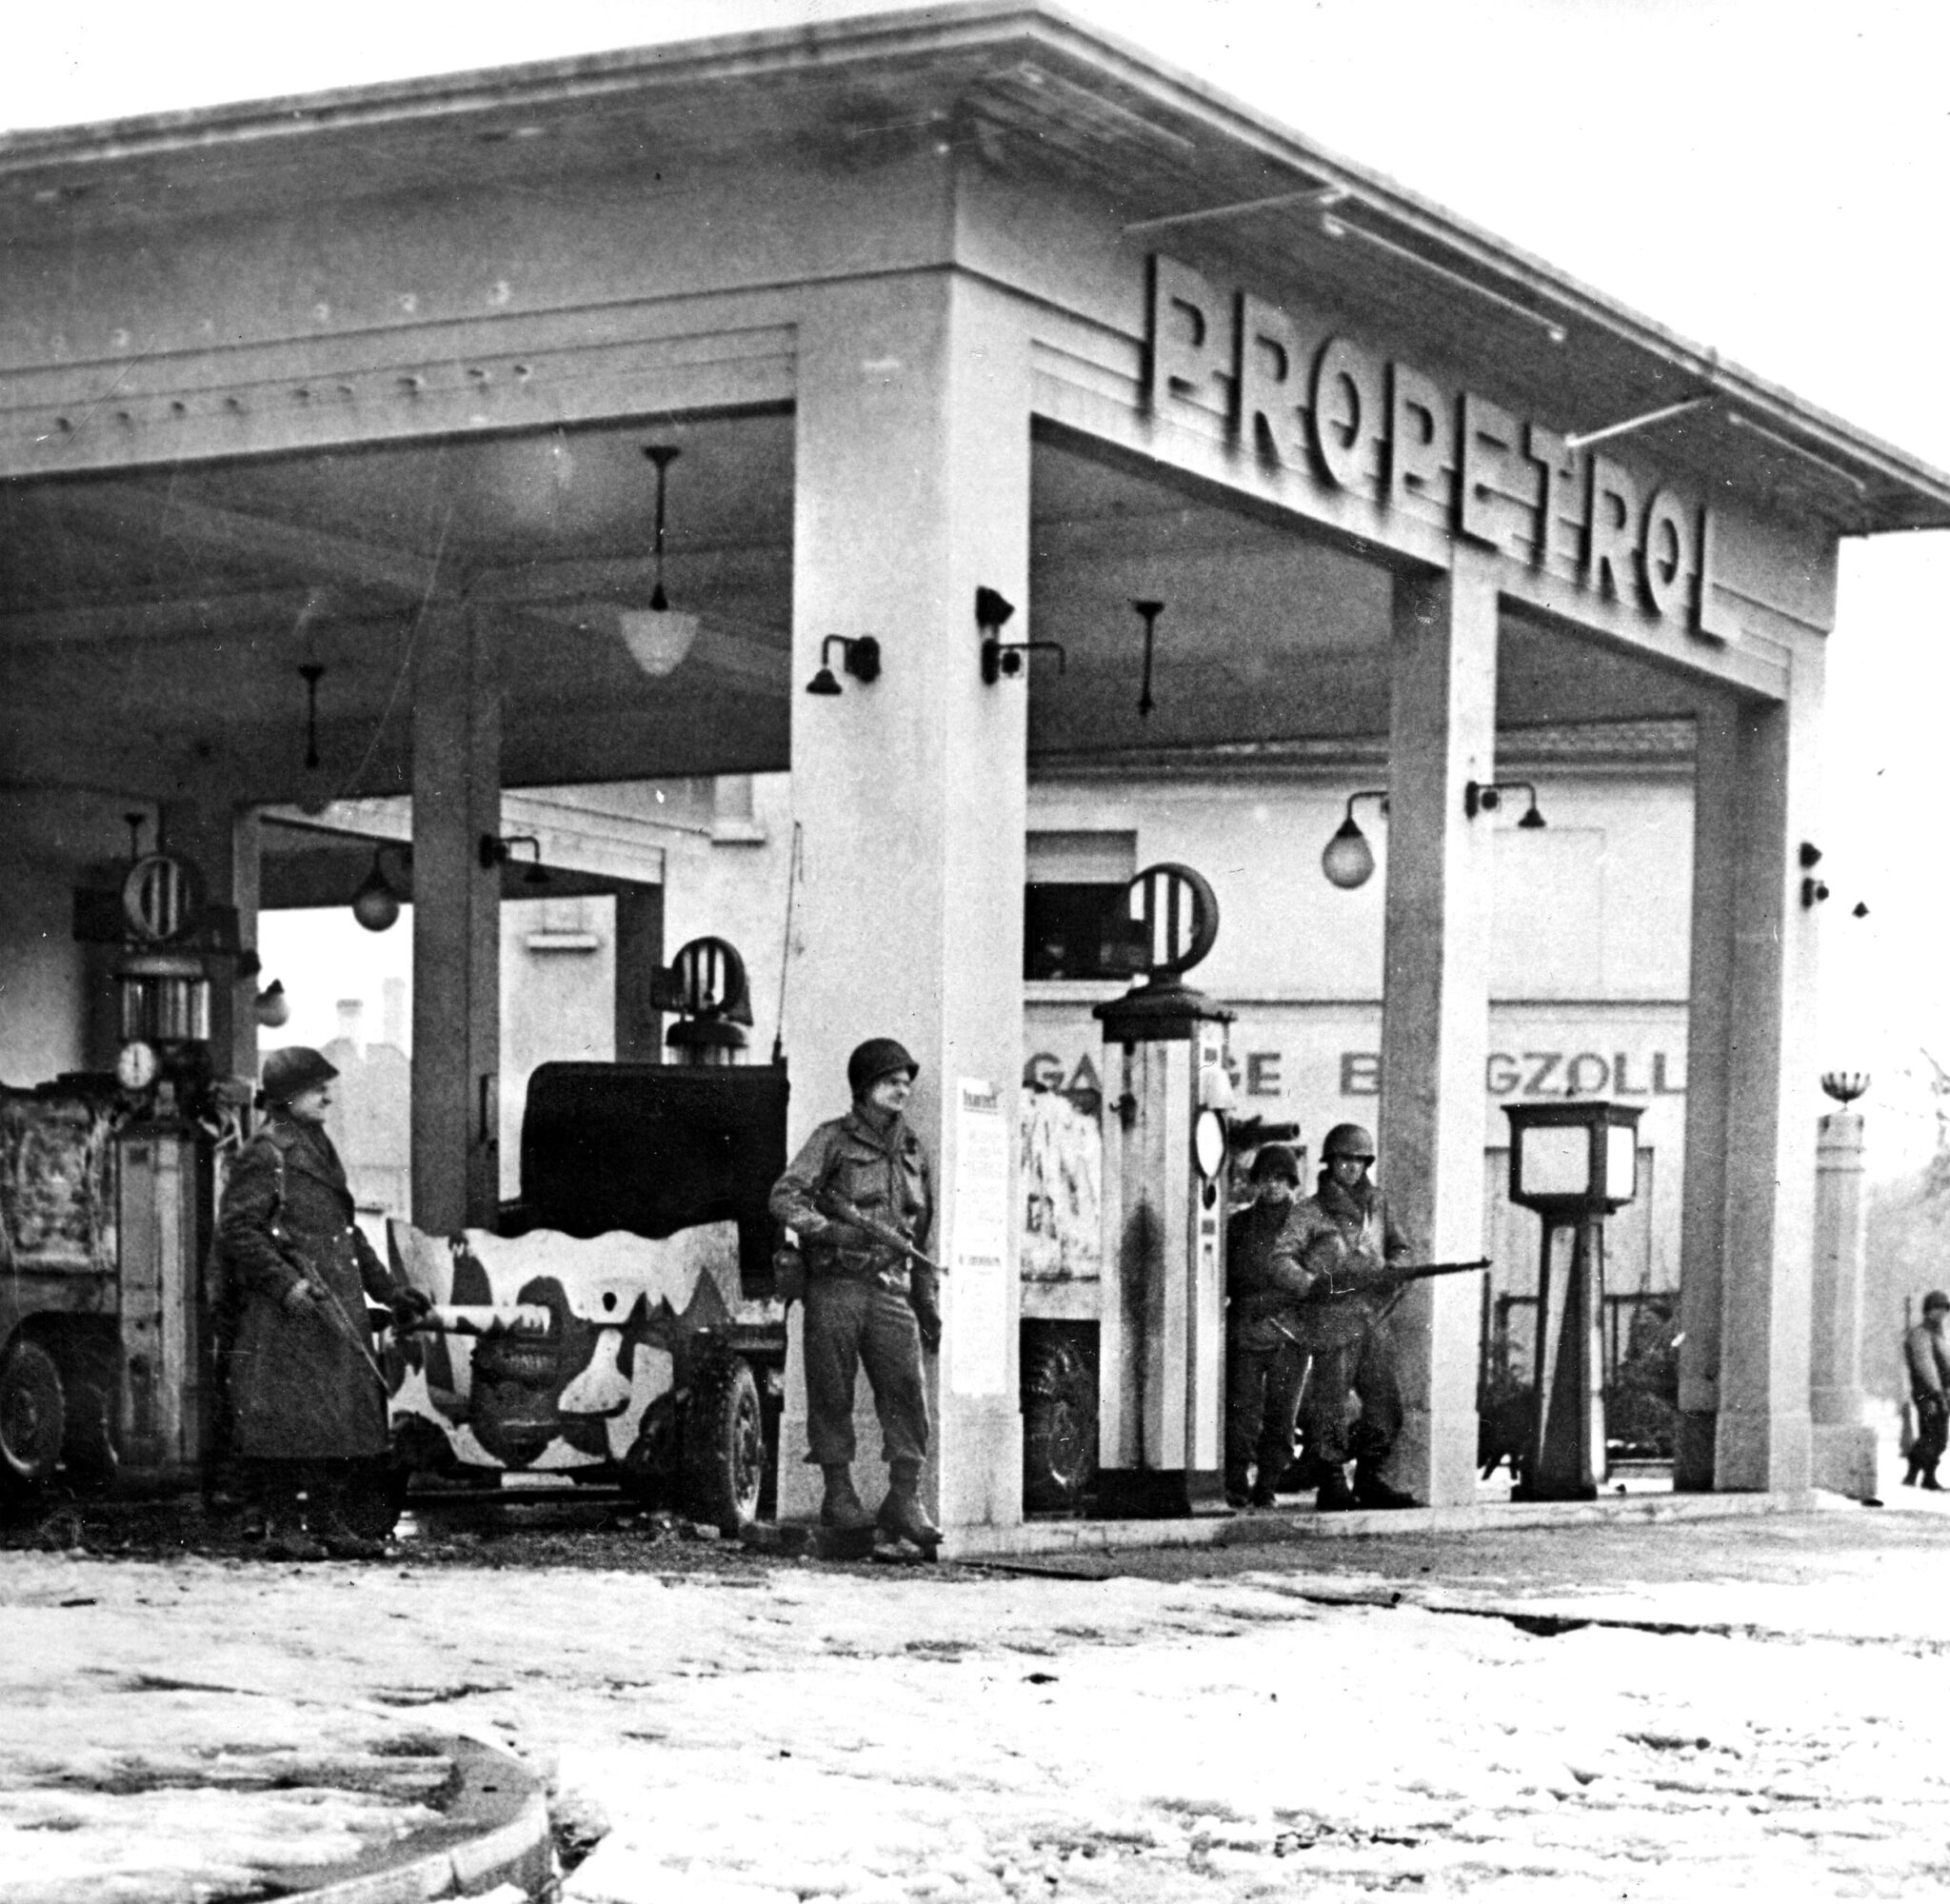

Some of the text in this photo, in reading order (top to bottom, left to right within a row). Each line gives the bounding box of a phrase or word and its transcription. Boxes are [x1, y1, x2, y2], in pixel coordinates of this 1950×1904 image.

[1144, 253, 1742, 647] PROPETROL
[1023, 1051, 1688, 1097] GAE BGZOLL
